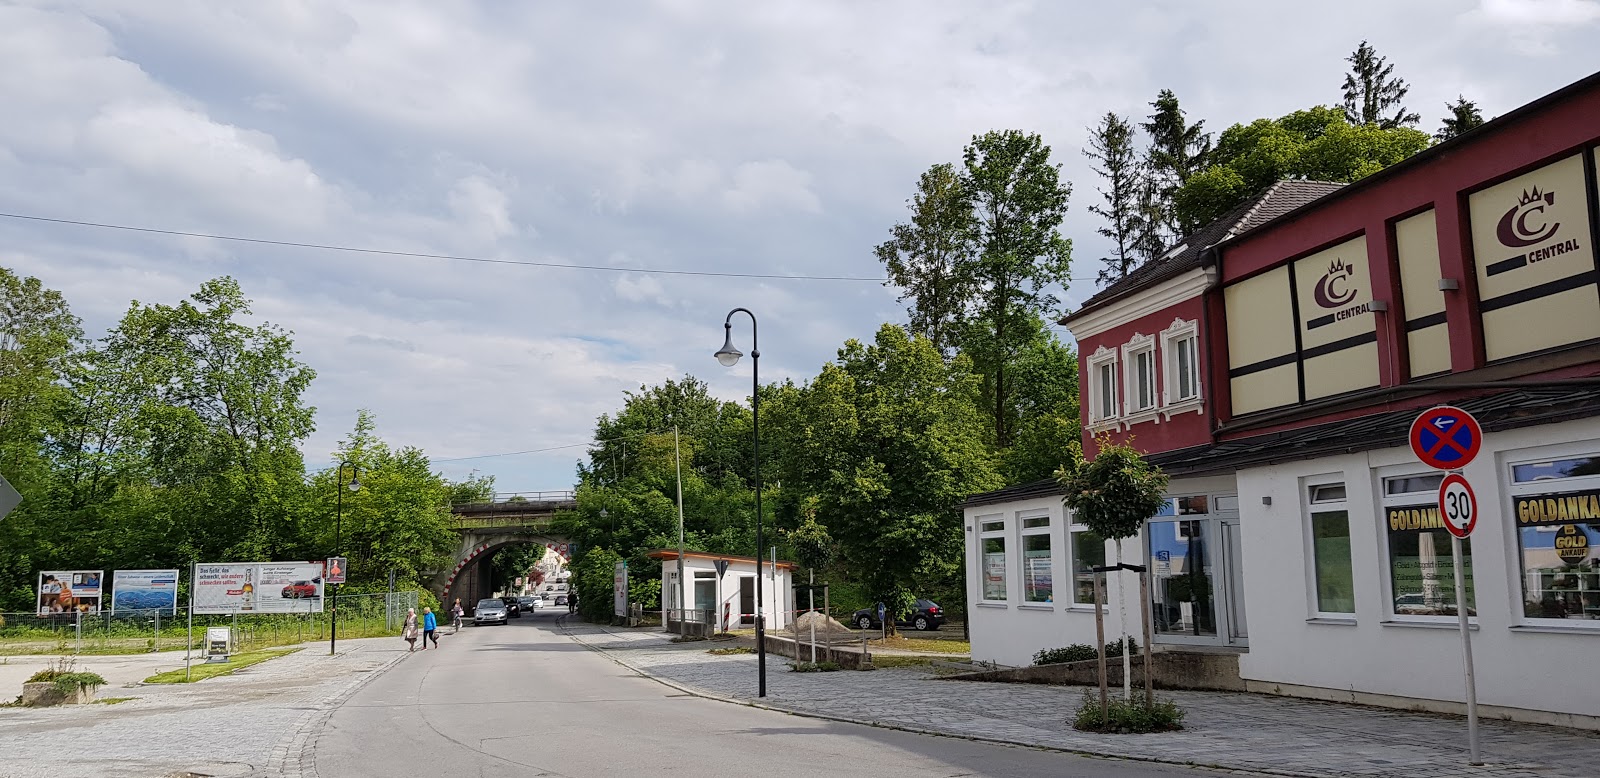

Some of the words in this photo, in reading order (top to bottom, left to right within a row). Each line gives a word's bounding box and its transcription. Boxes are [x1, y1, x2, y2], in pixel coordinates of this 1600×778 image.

[1529, 239, 1580, 263] CENTRAL
[1336, 303, 1370, 321] CENTRAL
[1447, 491, 1470, 520] 30
[1518, 494, 1600, 523] GOLDANKA
[1555, 536, 1587, 549] GOLD
